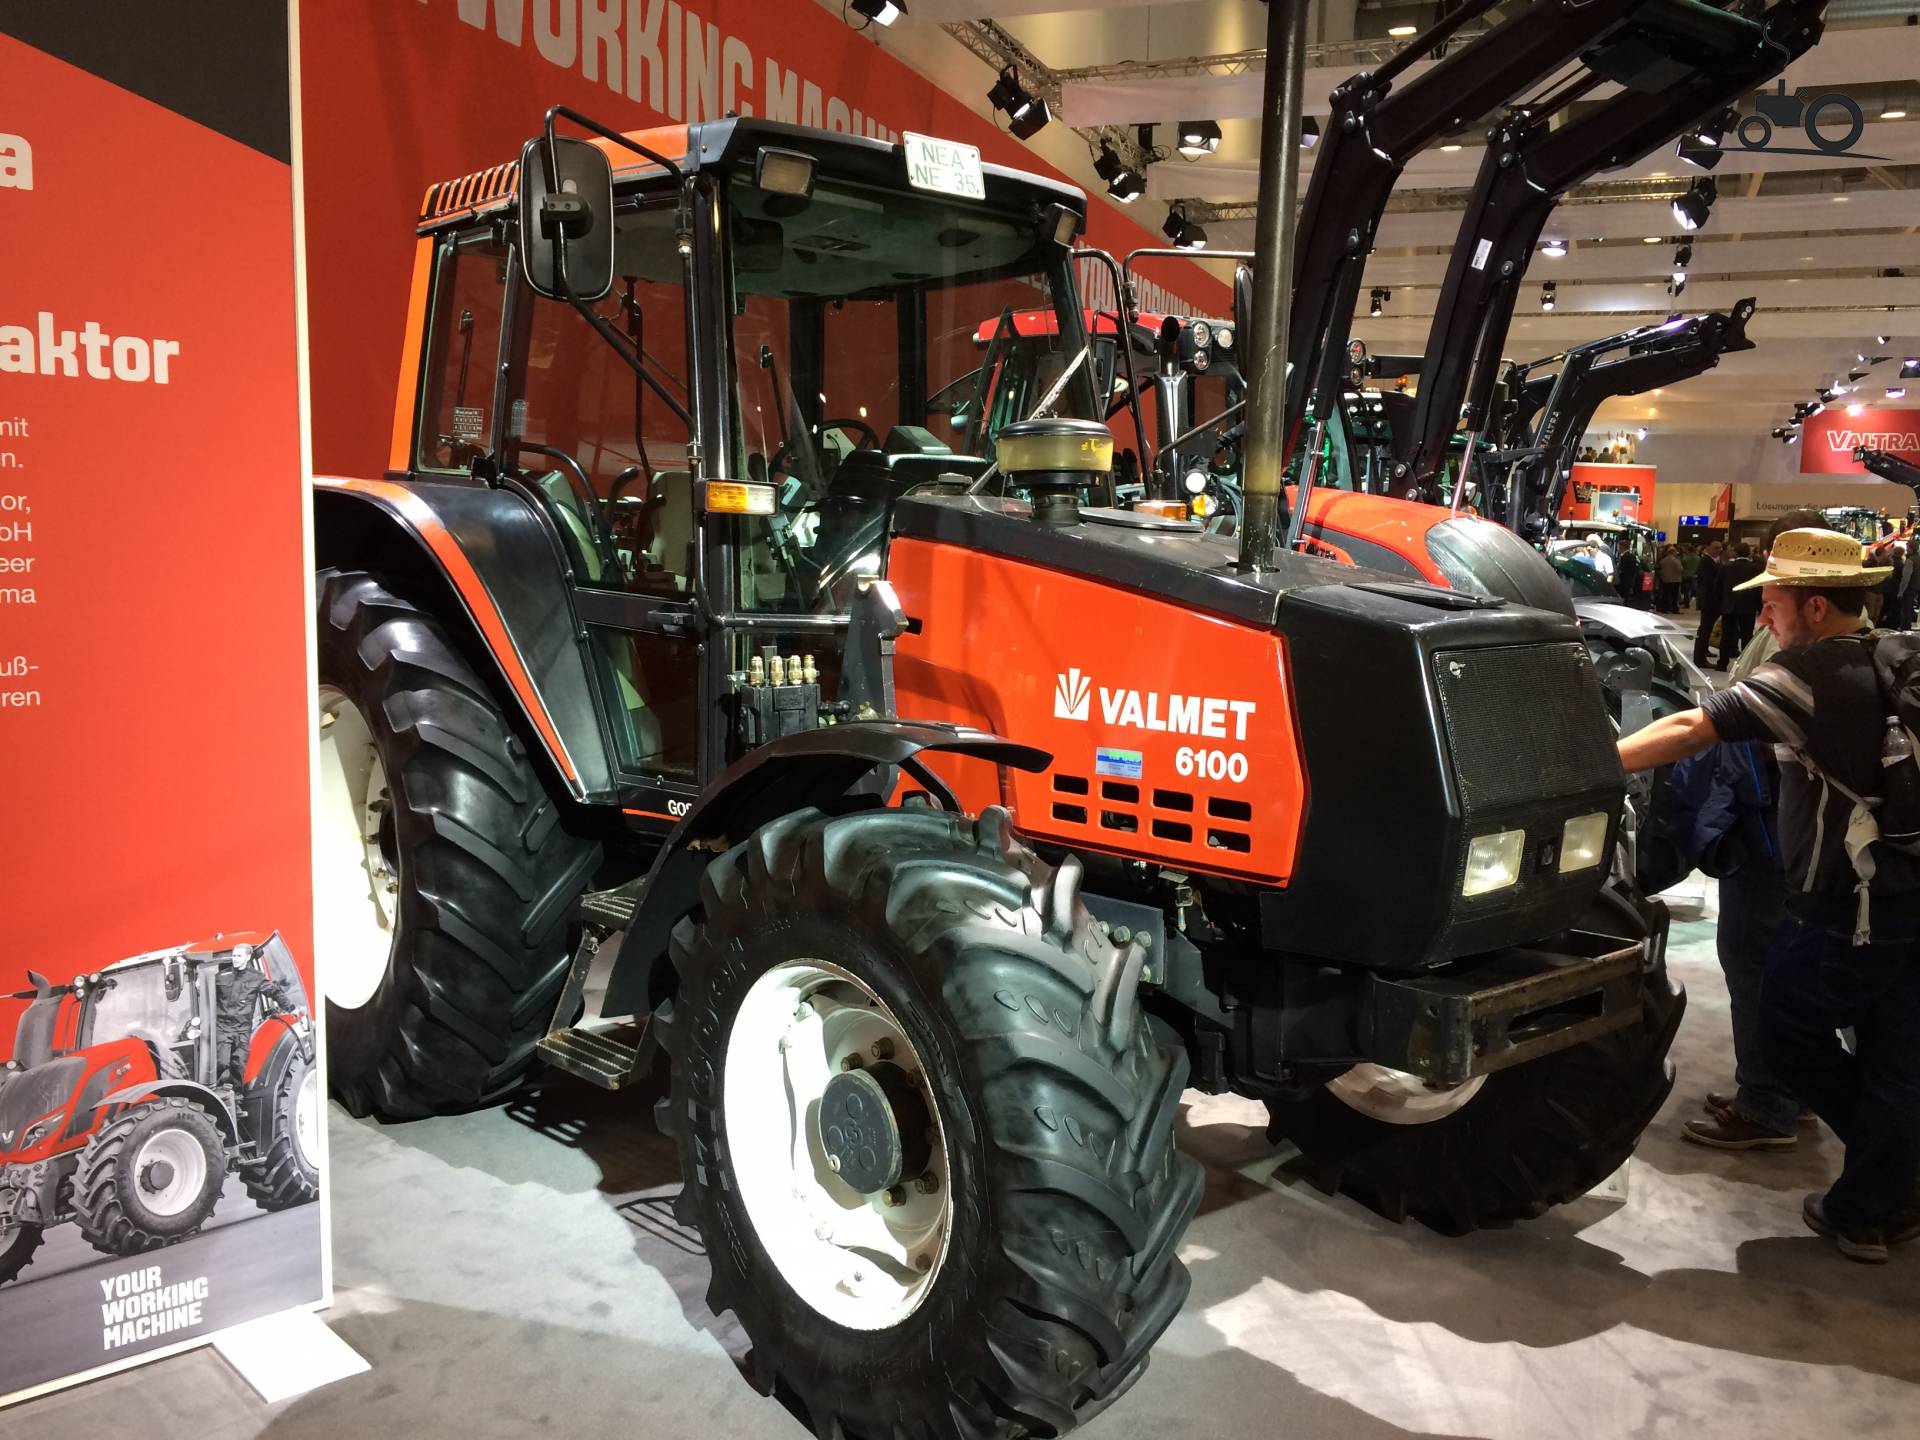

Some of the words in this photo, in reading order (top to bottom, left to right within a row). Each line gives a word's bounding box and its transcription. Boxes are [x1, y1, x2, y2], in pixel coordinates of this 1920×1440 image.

[921, 141, 965, 171] NEA
[914, 163, 943, 188] NE
[953, 172, 976, 194] 35
[0, 311, 180, 385] aktor
[1827, 430, 1920, 452] VALTRA
[1099, 687, 1256, 741] VALMET
[1175, 746, 1249, 783] 6100
[100, 1266, 162, 1302] YOUR
[101, 1276, 209, 1326] WORKING
[103, 1301, 203, 1351] MACHINE
